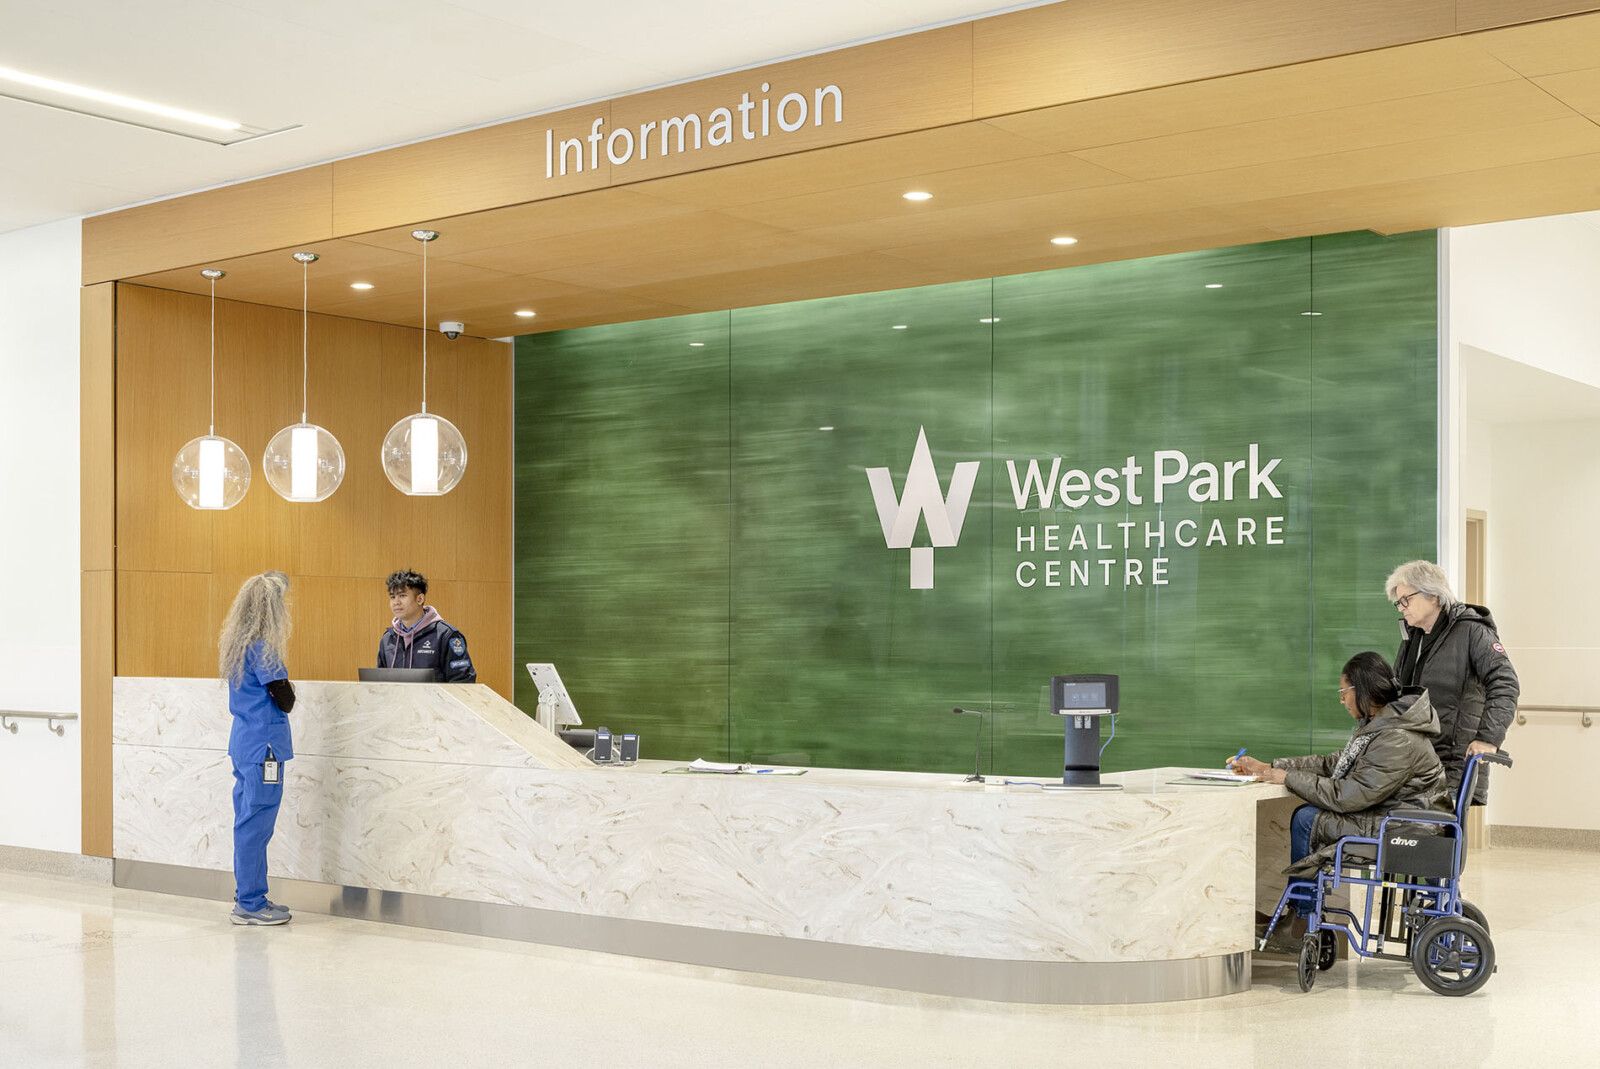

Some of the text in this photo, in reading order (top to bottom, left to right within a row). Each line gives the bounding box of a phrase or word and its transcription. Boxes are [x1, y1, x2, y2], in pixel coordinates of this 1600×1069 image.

[546, 82, 843, 178] Information
[1006, 443, 1284, 510] West Park
[1016, 516, 1285, 552] HEALTHCARE
[1015, 557, 1169, 588] CENTRE
[1390, 836, 1418, 847] drive
